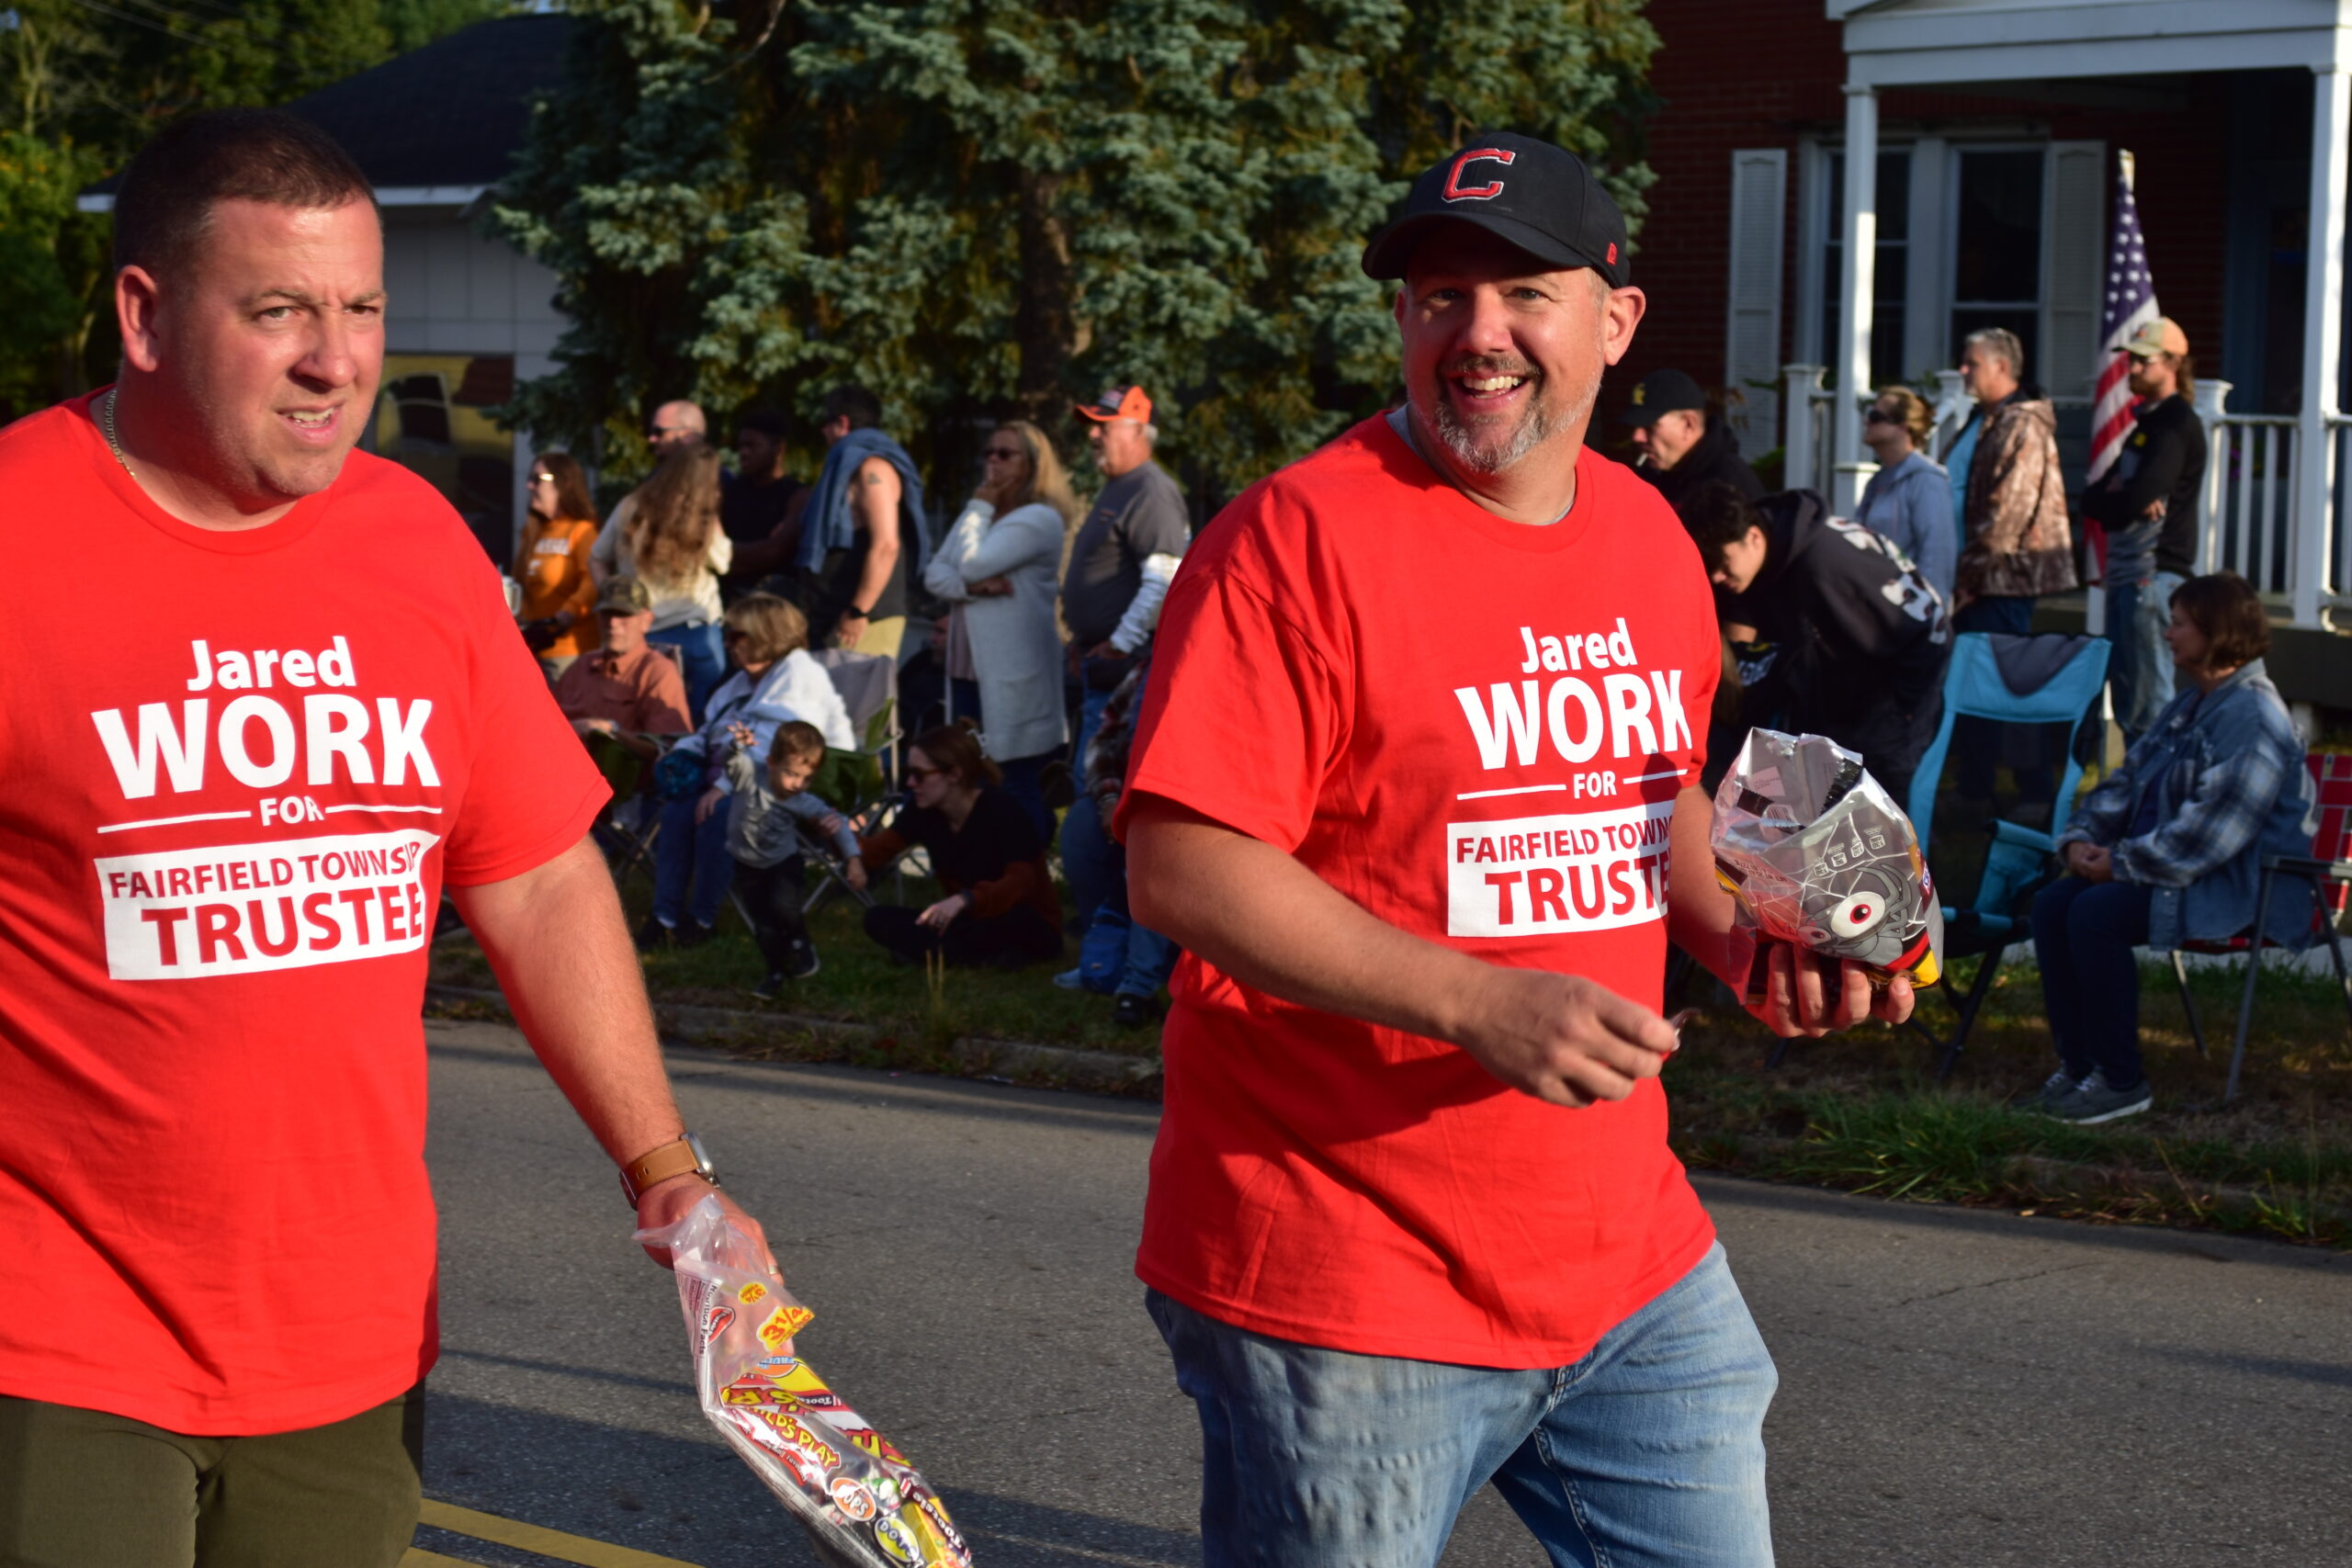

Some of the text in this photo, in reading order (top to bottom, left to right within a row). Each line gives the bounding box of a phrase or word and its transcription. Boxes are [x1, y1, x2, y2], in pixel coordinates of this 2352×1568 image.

[1442, 148, 1516, 203] C
[187, 636, 357, 692] Jared
[1520, 617, 1638, 674] Jared
[90, 694, 442, 800] WORK
[1453, 670, 1692, 771] WORK
[259, 795, 324, 827] FOR
[1573, 771, 1617, 799] FOR
[1456, 815, 1672, 864] FAIRFIELD TOWN
[107, 858, 294, 899] FAIRFIELD
[1485, 847, 1671, 926] TRUSTE
[141, 882, 423, 967] TRUSTEE
[699, 1328, 708, 1355] Facts
[797, 1396, 832, 1407] Toots
[797, 1430, 837, 1467] PLAY
[912, 1492, 962, 1550] Tootsie
